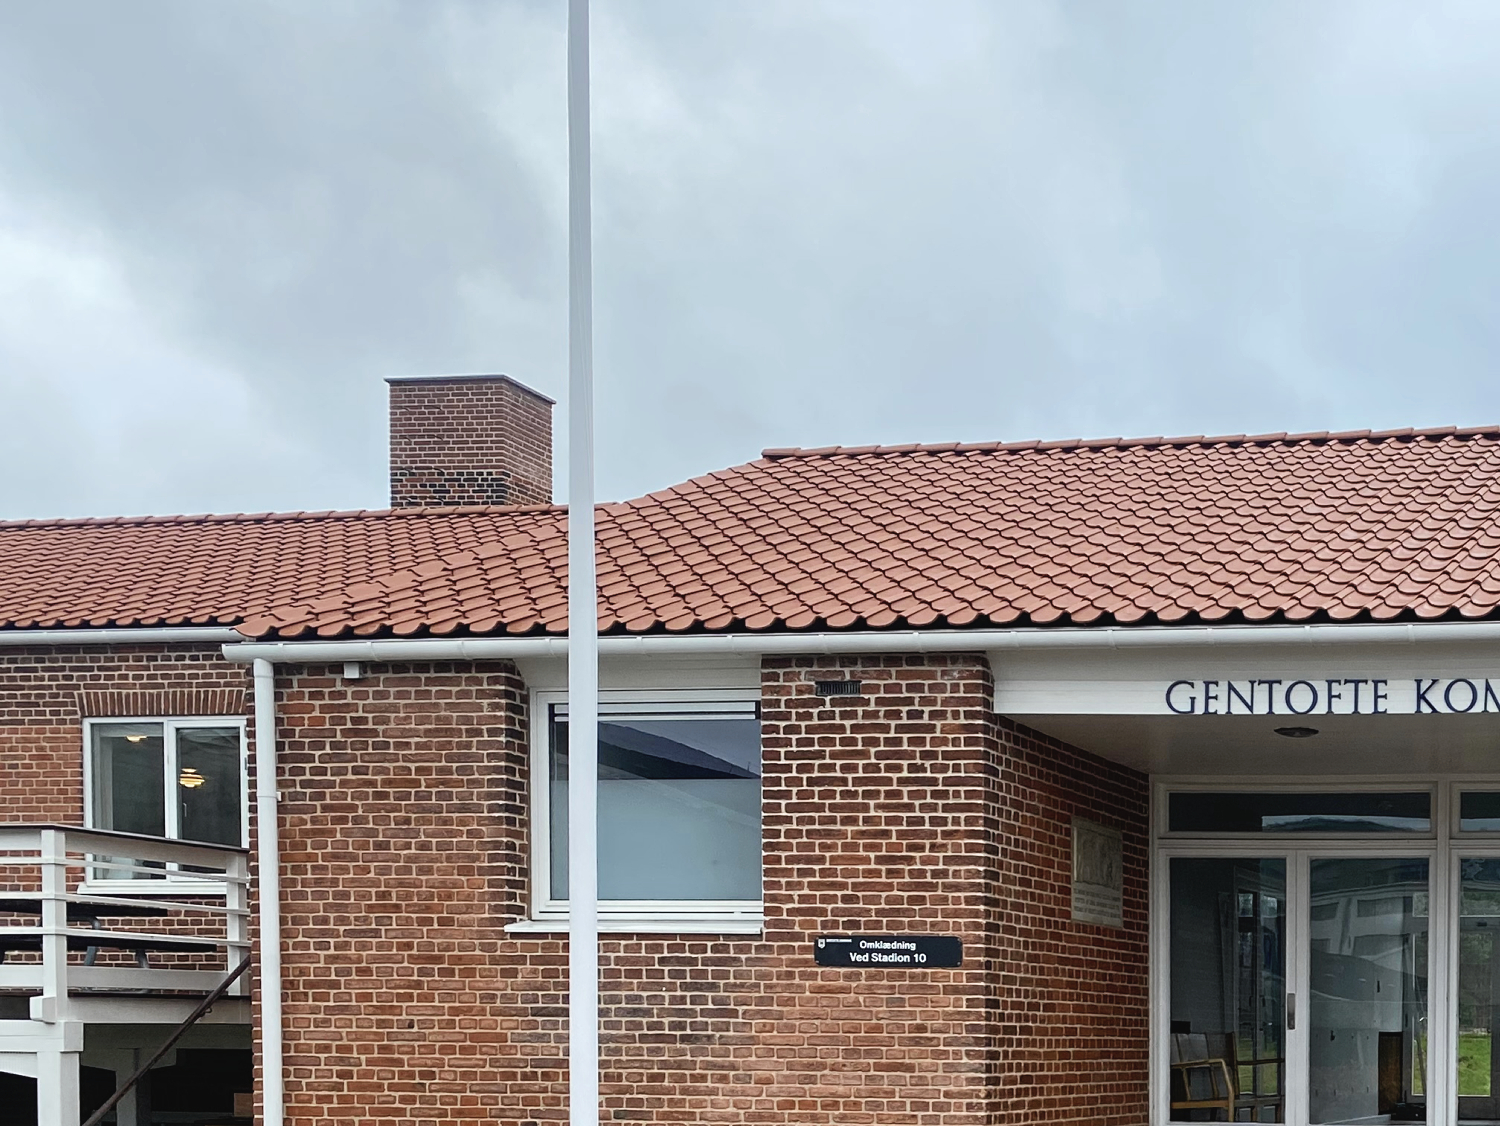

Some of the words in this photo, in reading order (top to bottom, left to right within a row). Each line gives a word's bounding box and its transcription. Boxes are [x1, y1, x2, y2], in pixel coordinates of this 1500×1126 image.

[1165, 679, 1388, 716] GENTOFTE
[859, 940, 917, 951] Omklædning
[849, 952, 869, 962] Ved
[871, 953, 911, 963] Stadion
[913, 953, 927, 963] 10
